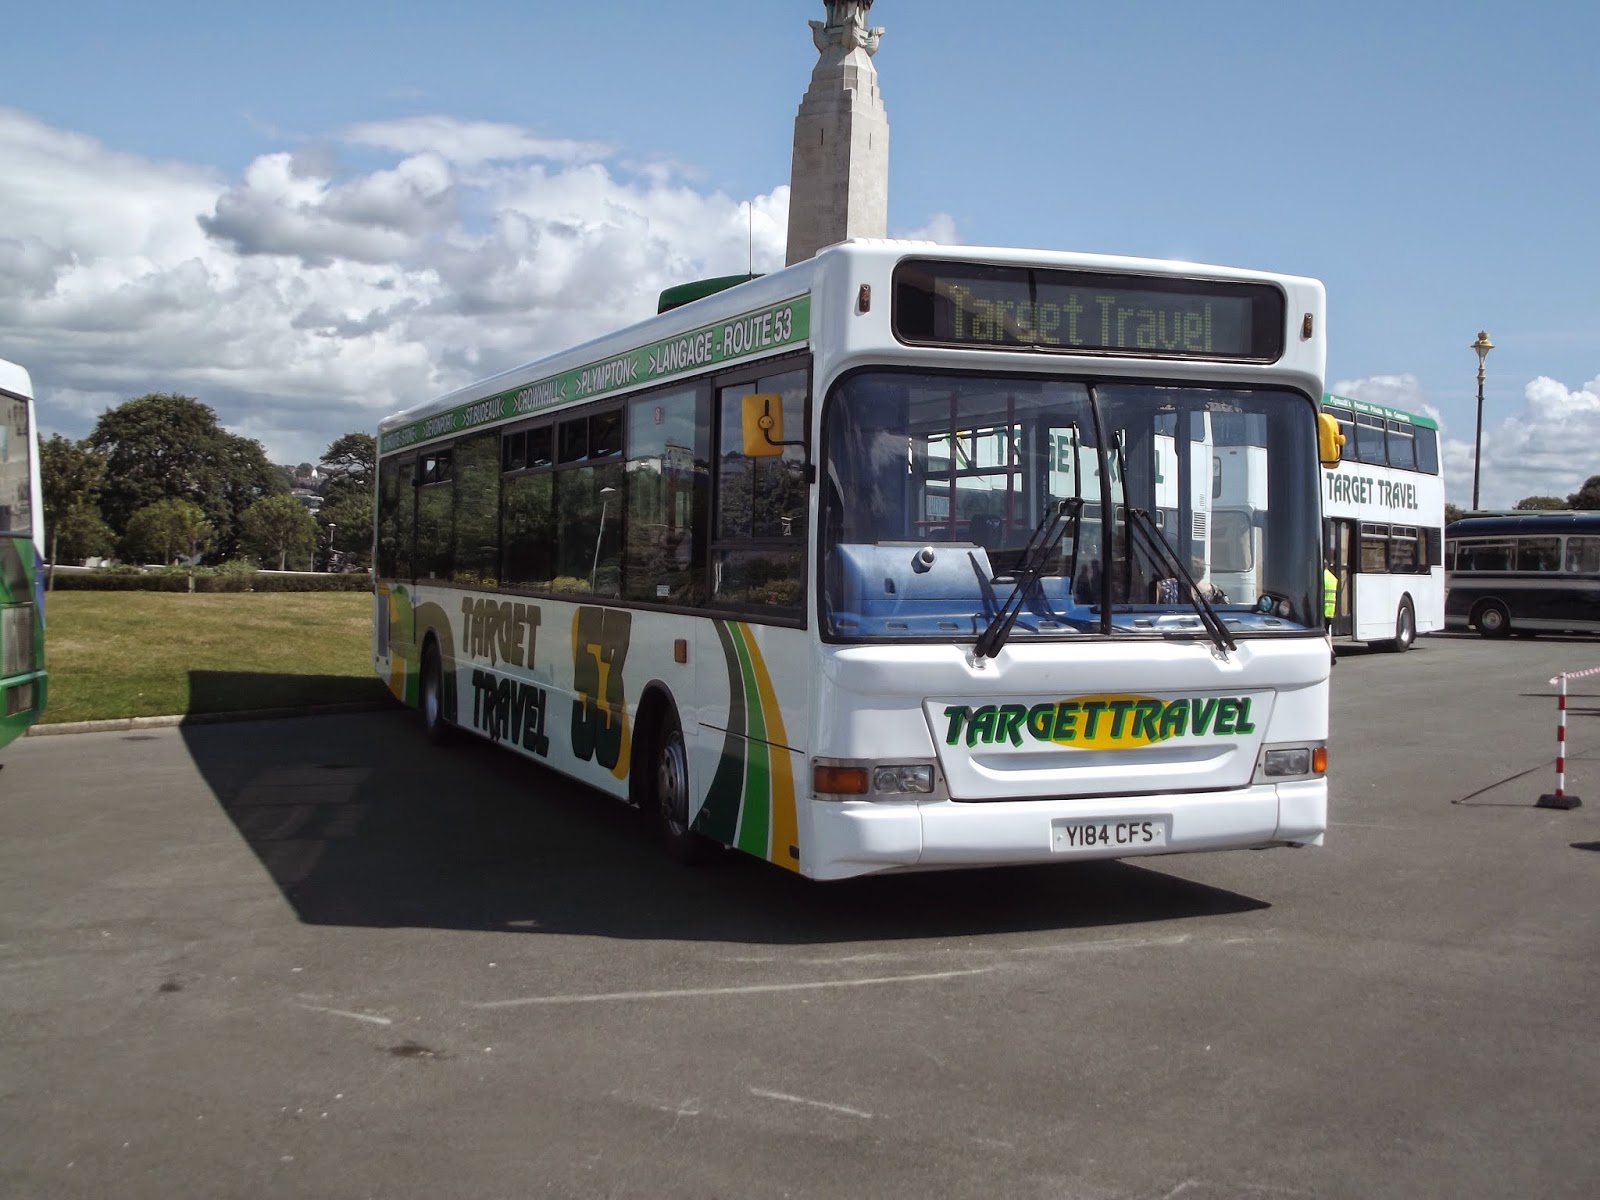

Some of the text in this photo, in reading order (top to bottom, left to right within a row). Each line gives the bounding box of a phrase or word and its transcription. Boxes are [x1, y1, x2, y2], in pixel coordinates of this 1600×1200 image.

[656, 307, 792, 374] LANGAGE ROUTE 53
[950, 285, 1212, 352] Target Travel
[517, 380, 560, 413] CROWNHILL
[581, 357, 631, 394] PLYMPTON
[1326, 472, 1418, 510] TARGET TRAVEL
[462, 596, 541, 671] TARGET
[472, 669, 549, 758] TRAVEL
[571, 605, 633, 771] 53
[1066, 822, 1153, 848] Y184 CFS
